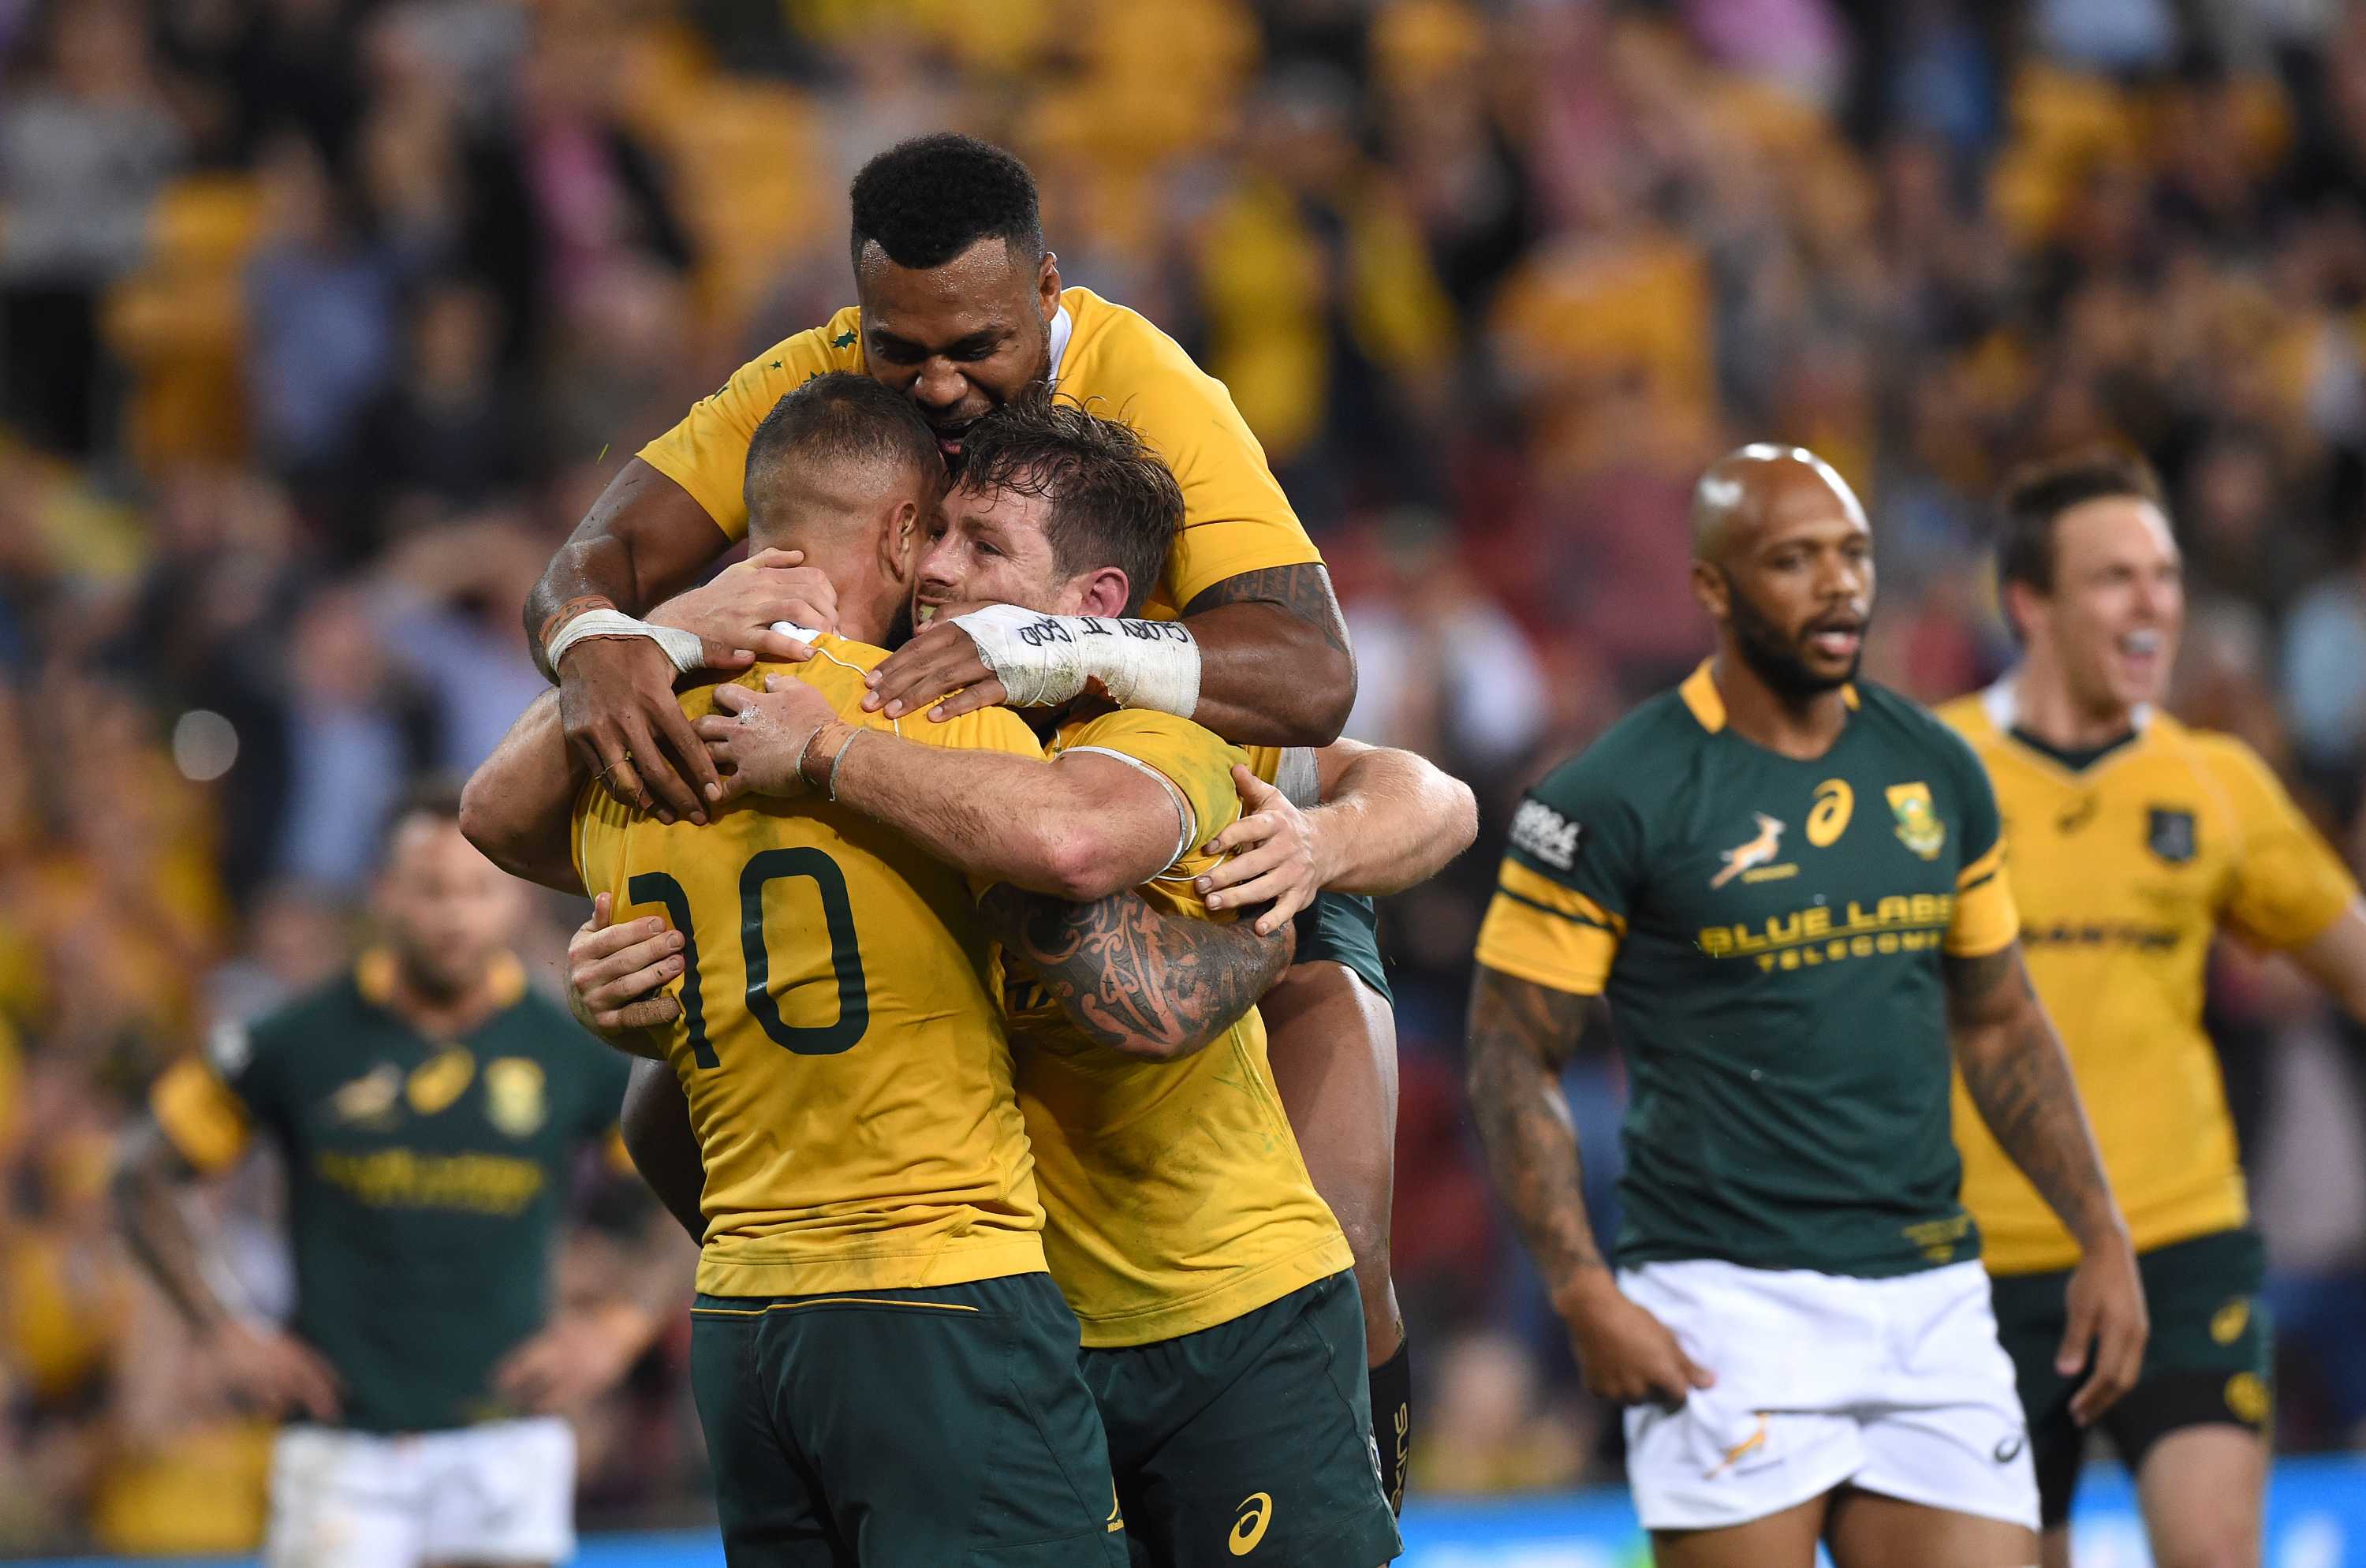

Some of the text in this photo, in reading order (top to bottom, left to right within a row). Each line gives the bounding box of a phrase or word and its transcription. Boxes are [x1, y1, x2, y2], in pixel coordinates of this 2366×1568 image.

[1017, 616, 1072, 646] GOD
[1117, 618, 1189, 643] GLORY
[1699, 905, 1830, 954] BLUE
[628, 846, 869, 1069] 10
